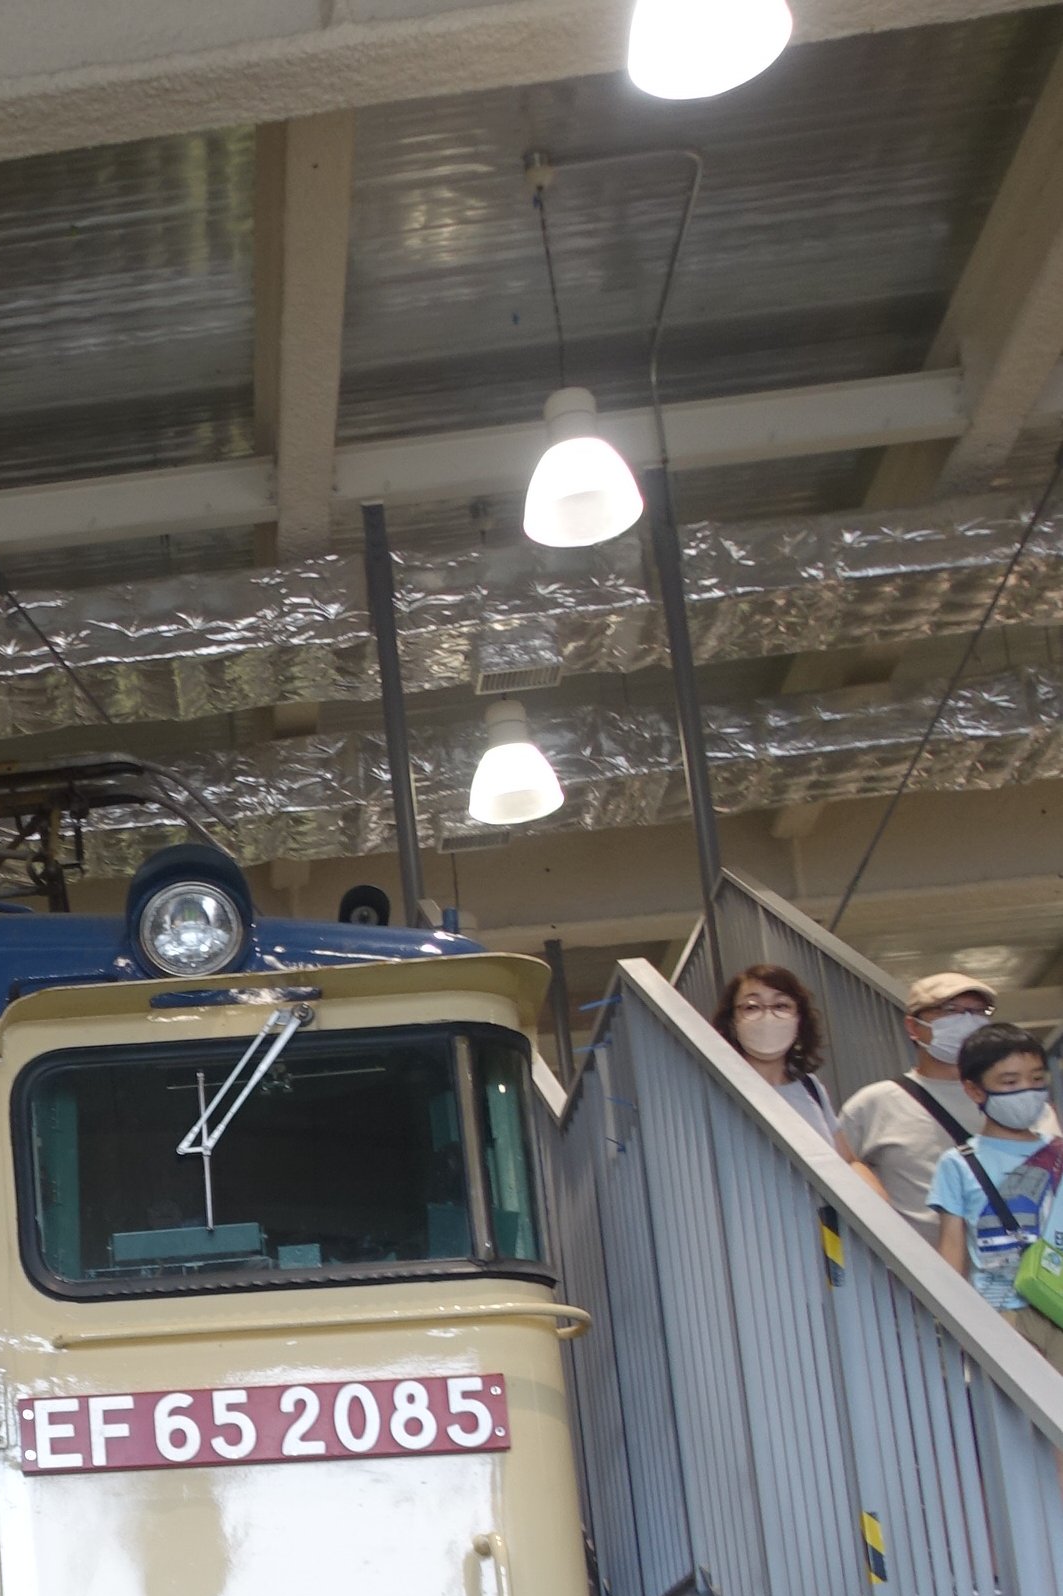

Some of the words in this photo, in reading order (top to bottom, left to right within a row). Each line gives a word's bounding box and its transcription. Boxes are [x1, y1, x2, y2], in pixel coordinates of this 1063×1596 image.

[35, 1395, 135, 1469] EF
[153, 1389, 257, 1462] 65
[280, 1376, 494, 1457] 2085
